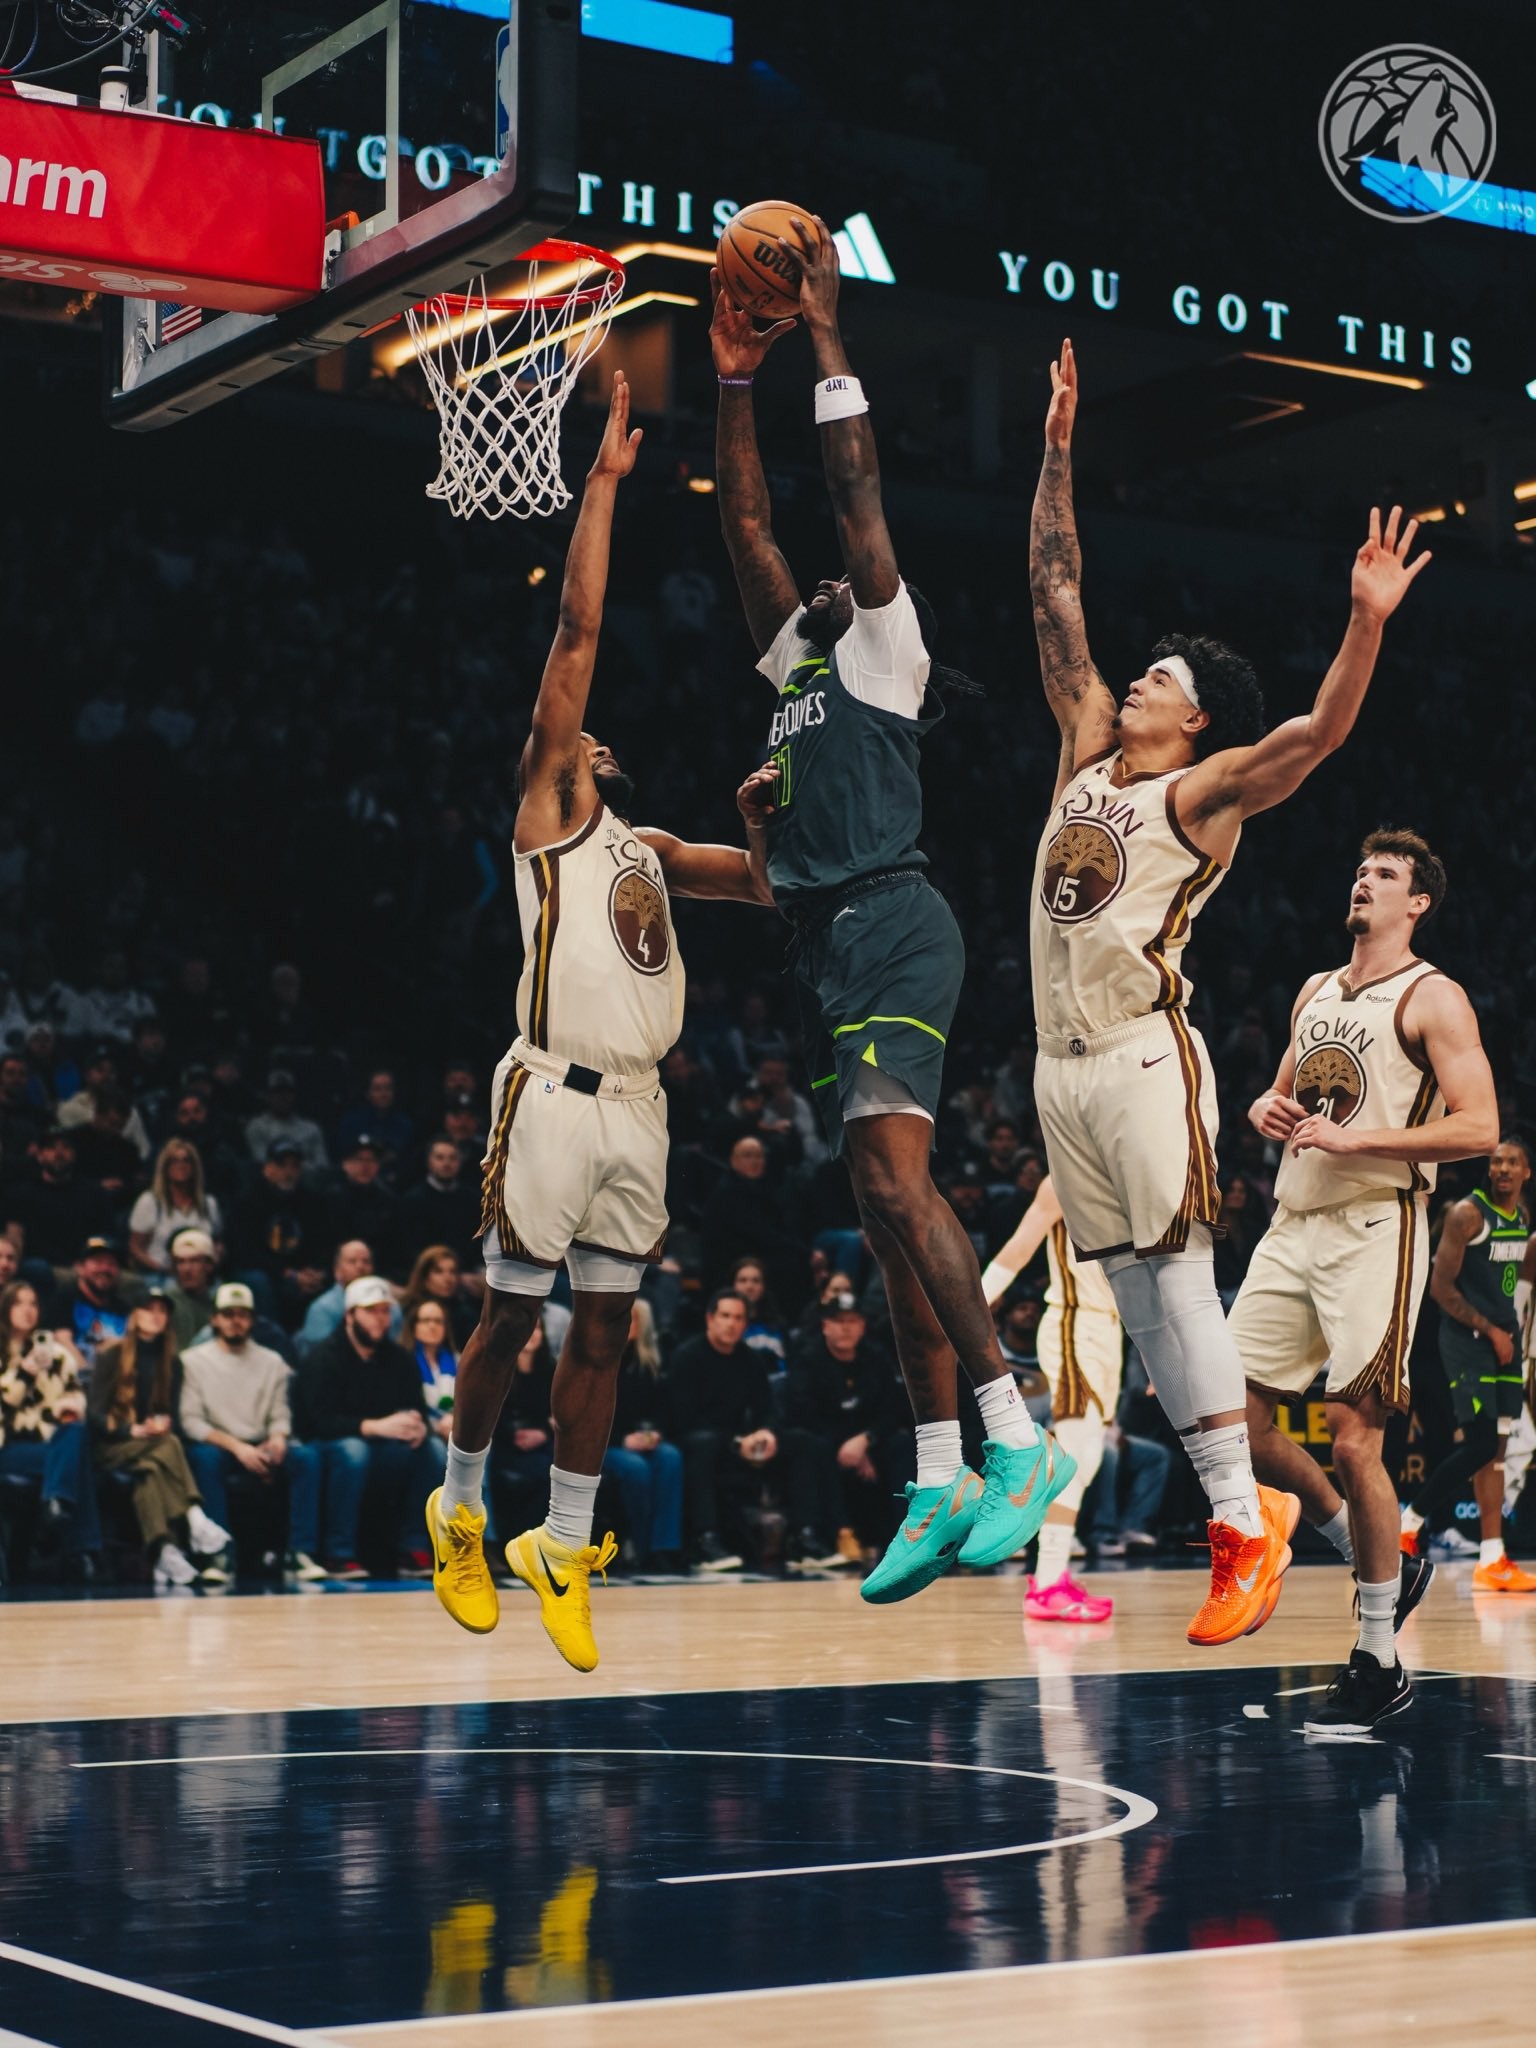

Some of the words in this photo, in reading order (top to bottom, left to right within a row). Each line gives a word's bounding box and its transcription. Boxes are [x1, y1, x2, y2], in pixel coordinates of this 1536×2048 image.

[578, 171, 740, 239] THIS
[998, 250, 1119, 310] YOU
[1172, 284, 1289, 341] GOT
[1337, 314, 1472, 375] THIS
[825, 378, 848, 392] TAYP
[1052, 875, 1081, 912] 15
[637, 928, 650, 963] 4
[1297, 1016, 1375, 1055] TOWN
[1502, 1263, 1517, 1297] 8
